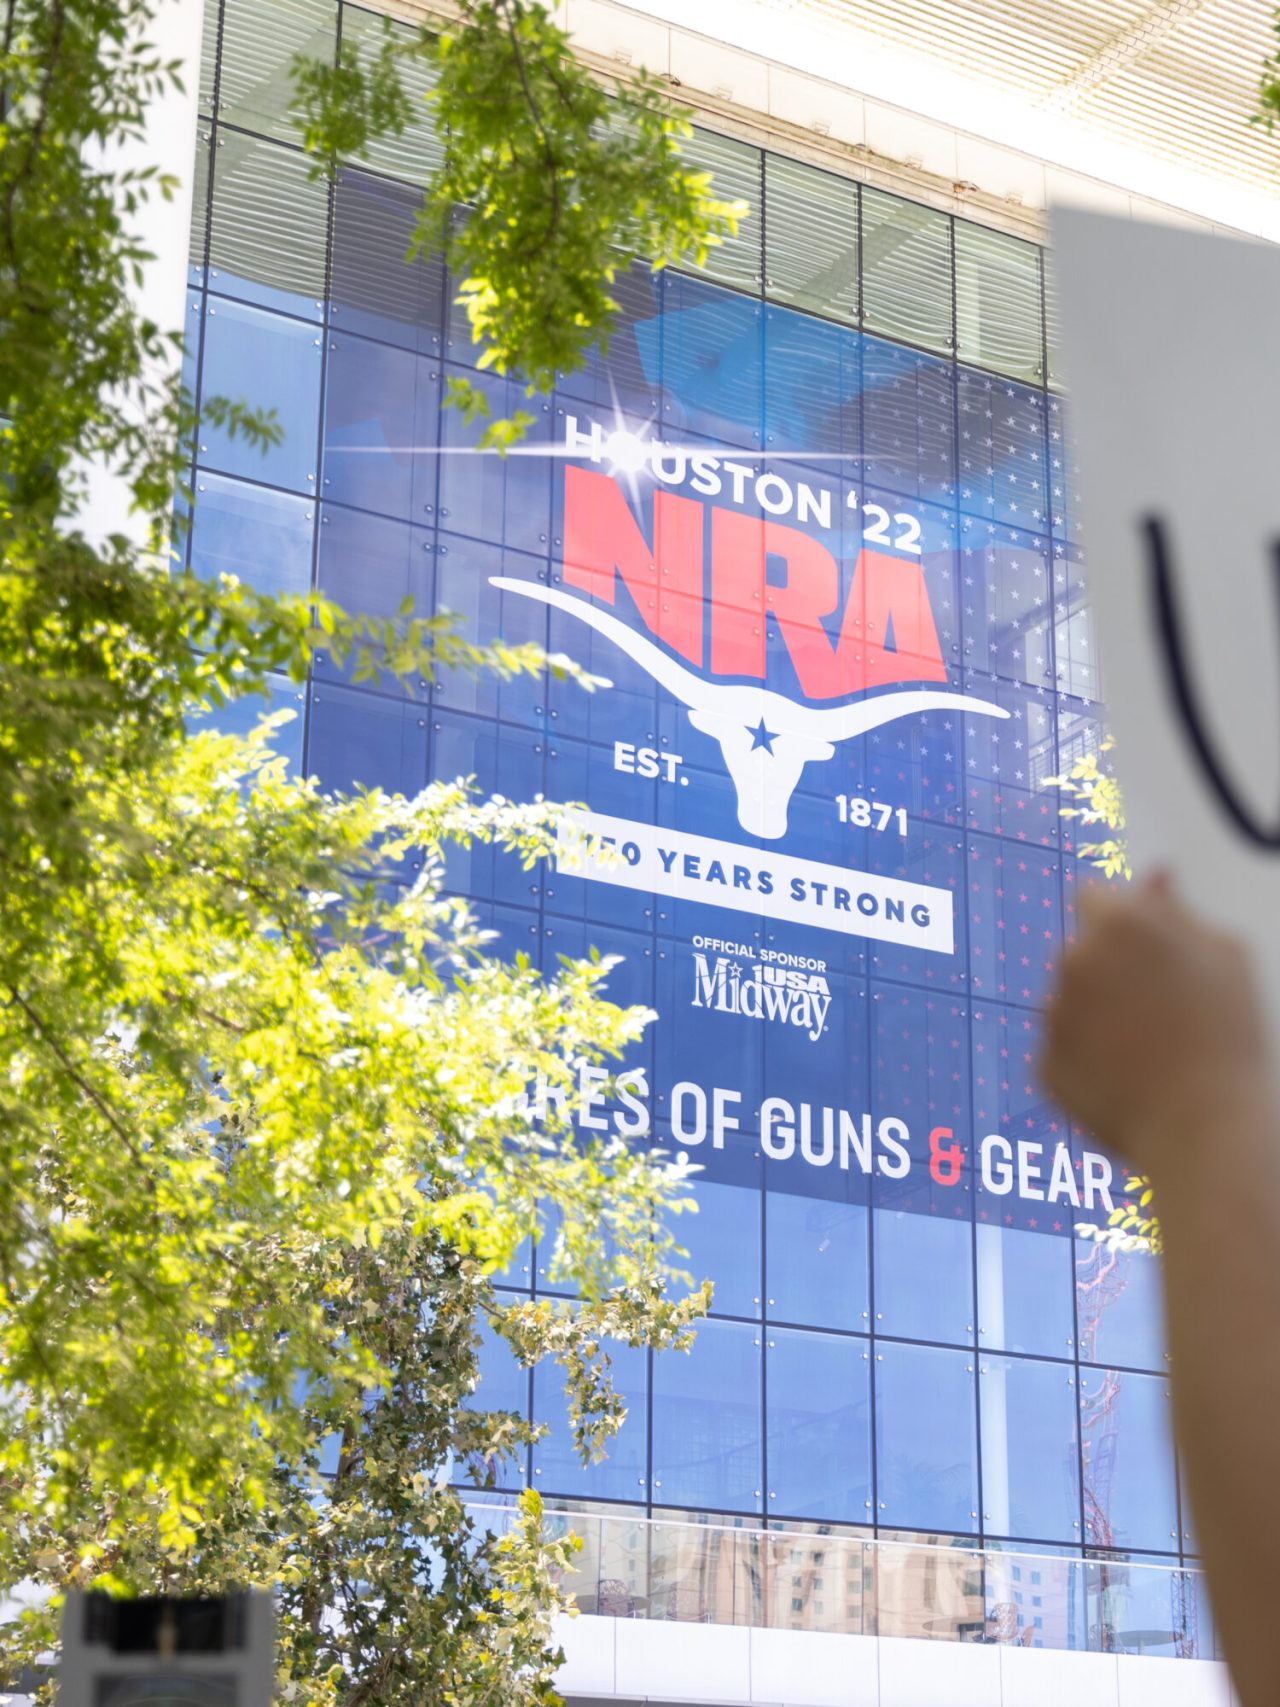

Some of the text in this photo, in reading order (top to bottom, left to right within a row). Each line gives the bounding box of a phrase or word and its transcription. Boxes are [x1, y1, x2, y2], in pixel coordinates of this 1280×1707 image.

[565, 415, 832, 529] HUSTON
[562, 464, 948, 699] NRA
[614, 741, 690, 786] EST.
[835, 794, 908, 836] 1871
[657, 848, 774, 895] YEARS
[790, 878, 931, 928] STRONG
[692, 935, 827, 972] OFFICIAL SPONSOR
[763, 965, 831, 996] USA
[691, 952, 832, 1041] Midway
[671, 1081, 741, 1149] OF
[761, 1097, 911, 1179] GUNS
[929, 1126, 965, 1186] &
[981, 1134, 1115, 1213] GEAR
